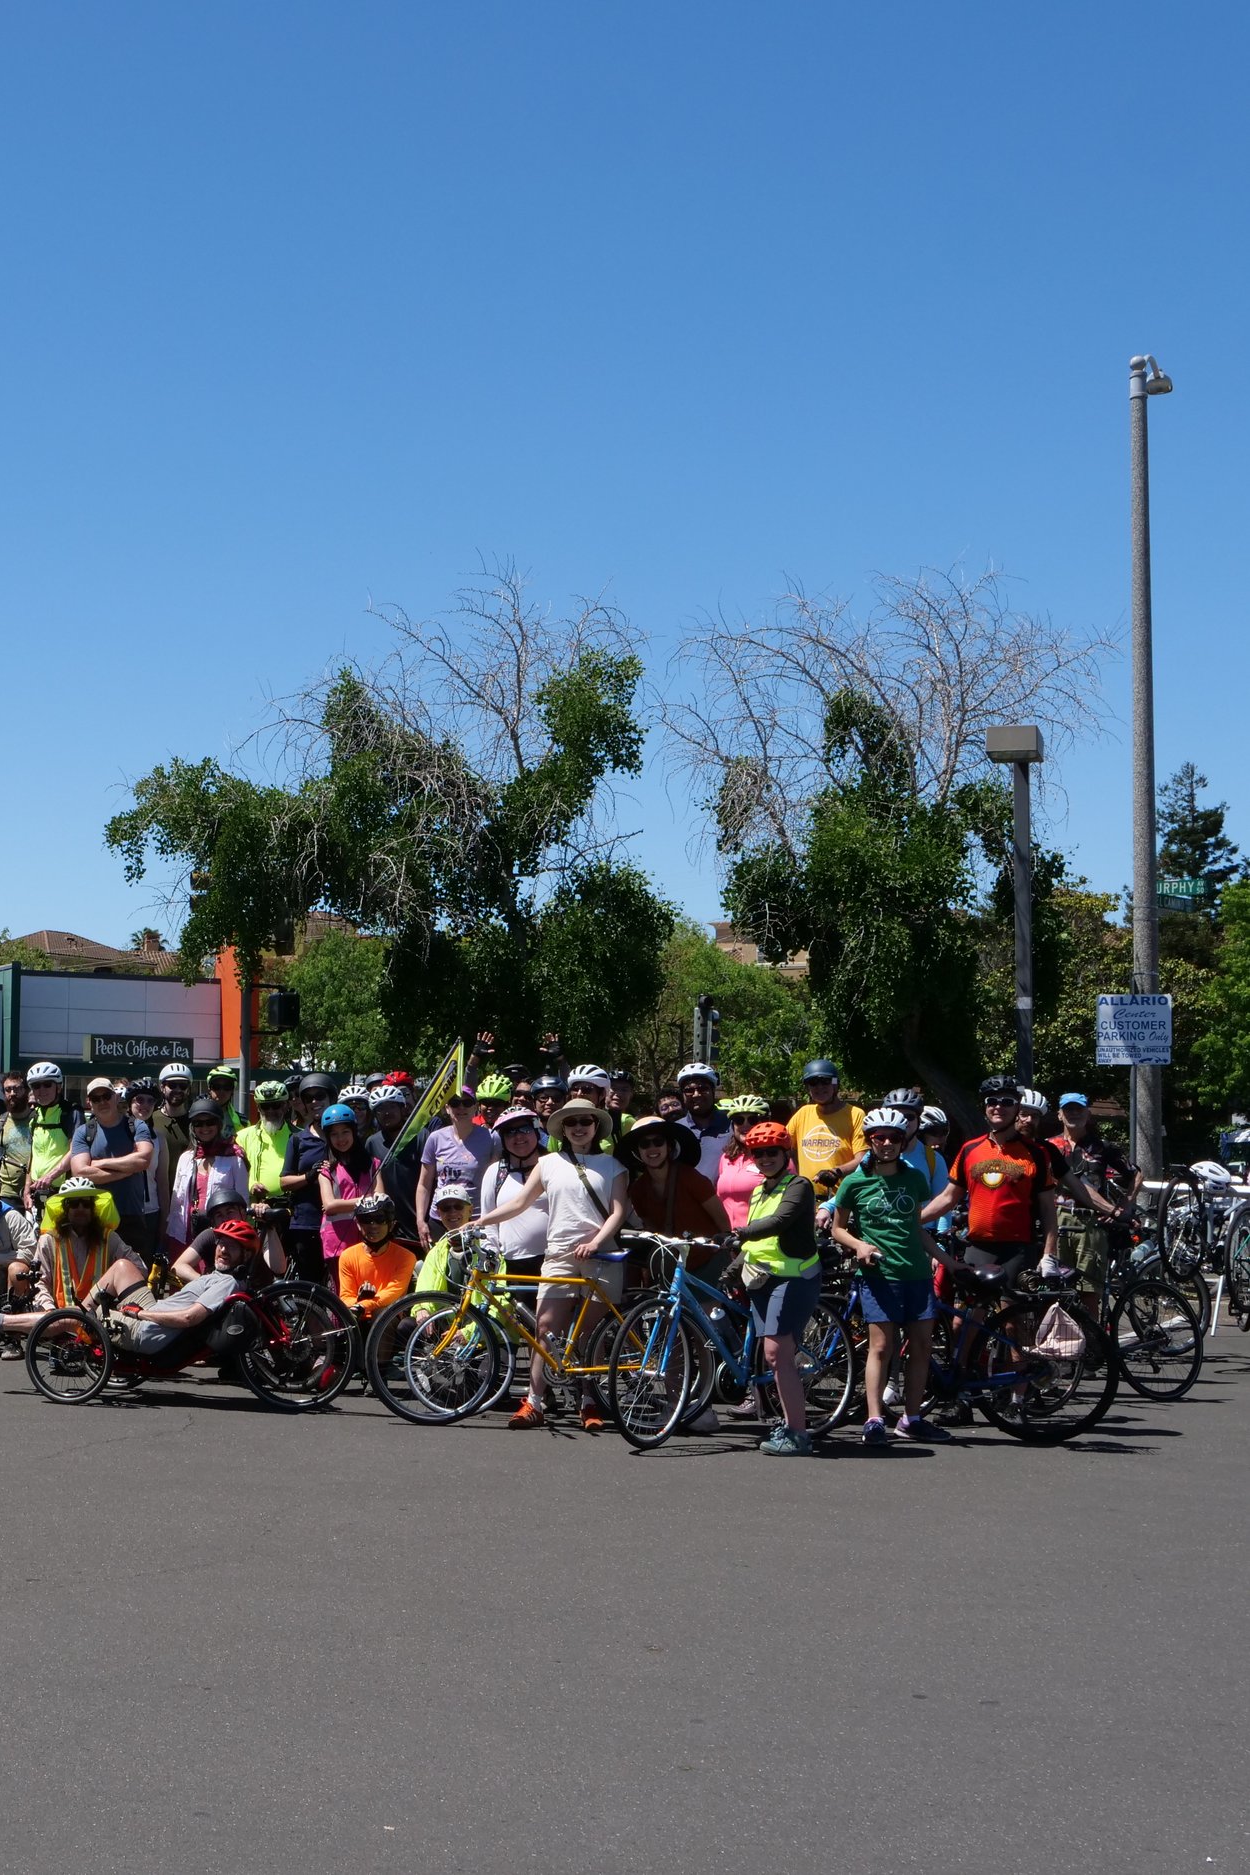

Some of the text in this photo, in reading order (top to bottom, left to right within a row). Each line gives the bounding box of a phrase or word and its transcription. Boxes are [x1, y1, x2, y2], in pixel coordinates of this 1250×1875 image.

[1156, 881, 1194, 894] URPHY
[1098, 995, 1169, 1006] ALLARIO
[1113, 1008, 1157, 1020] Center
[1100, 1020, 1167, 1031] CUSTOMER
[1097, 1031, 1169, 1044] PARKING Only
[93, 1037, 190, 1060] Peet's Coffee & Tea
[801, 1138, 842, 1148] WARRIORS
